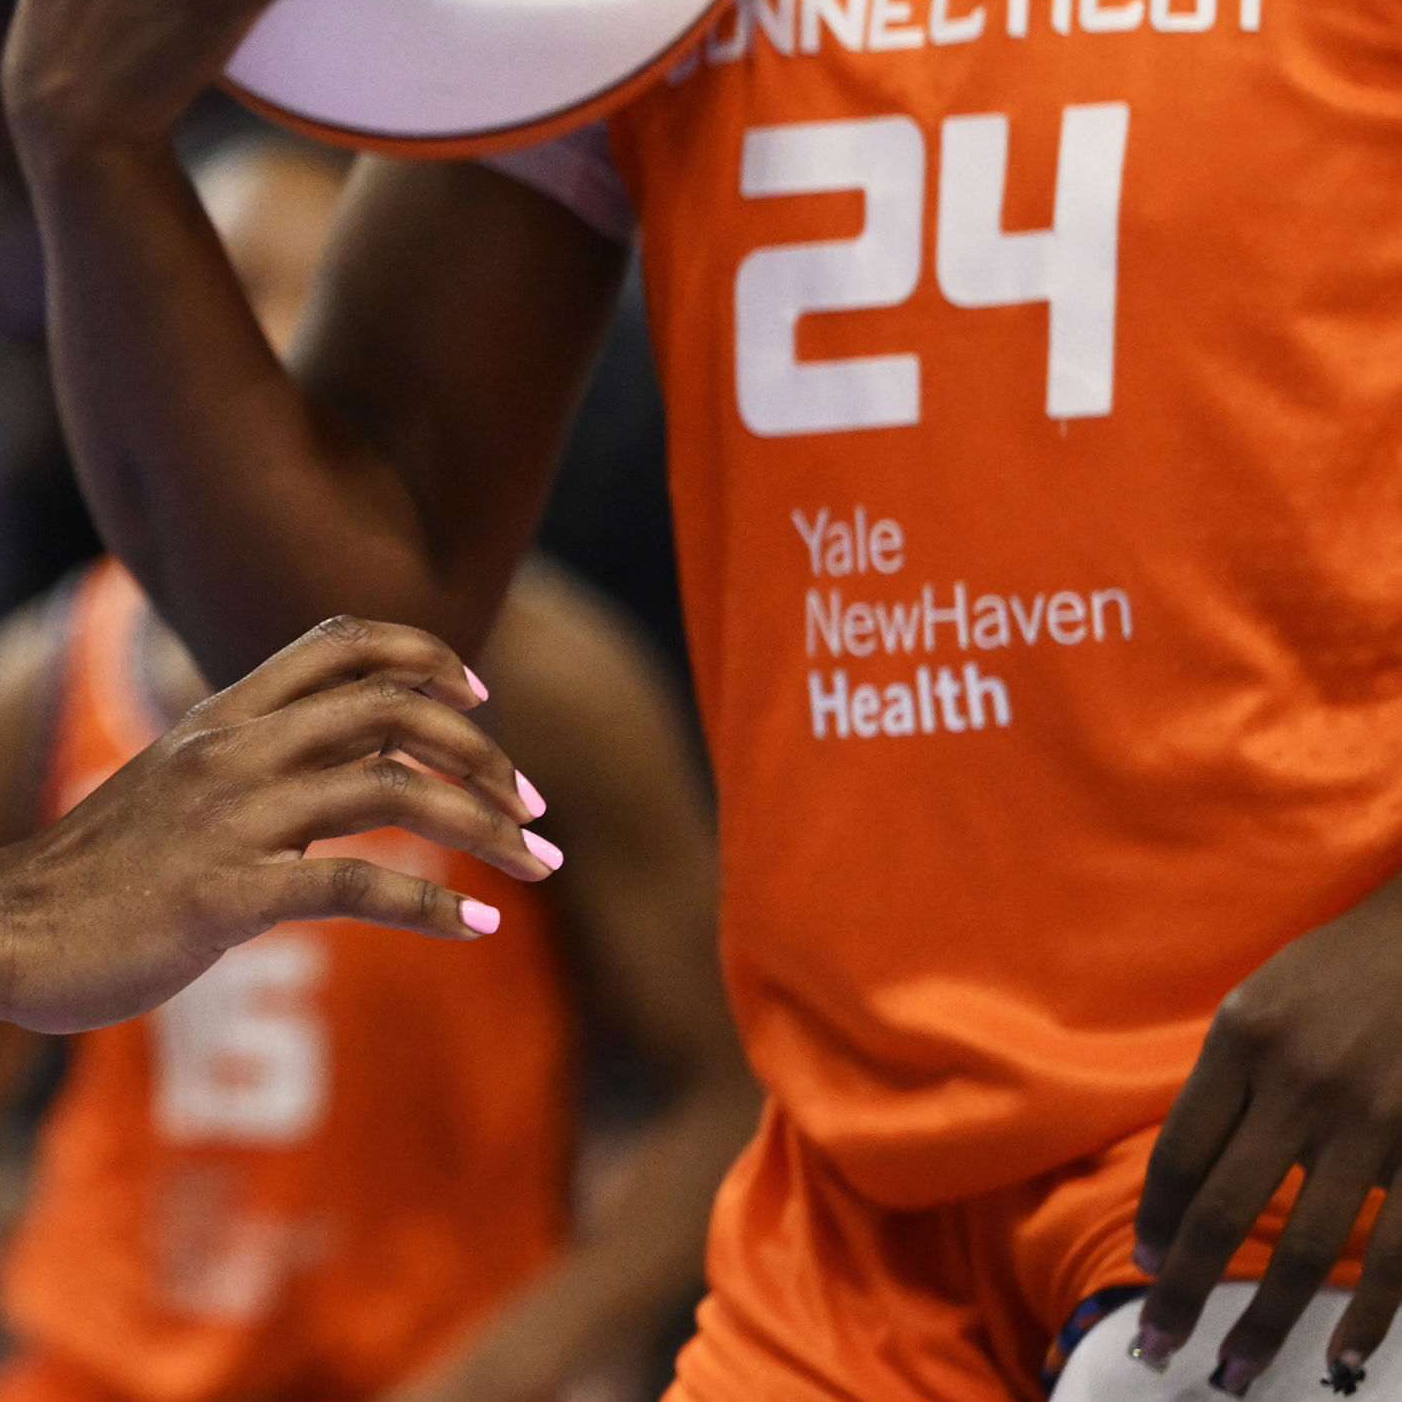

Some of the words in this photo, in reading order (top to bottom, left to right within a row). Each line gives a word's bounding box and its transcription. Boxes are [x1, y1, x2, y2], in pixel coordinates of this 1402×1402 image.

[733, 100, 1131, 438] 24
[791, 503, 905, 577] Yale
[804, 579, 1133, 659] NewHaven
[807, 661, 1011, 740] Health
